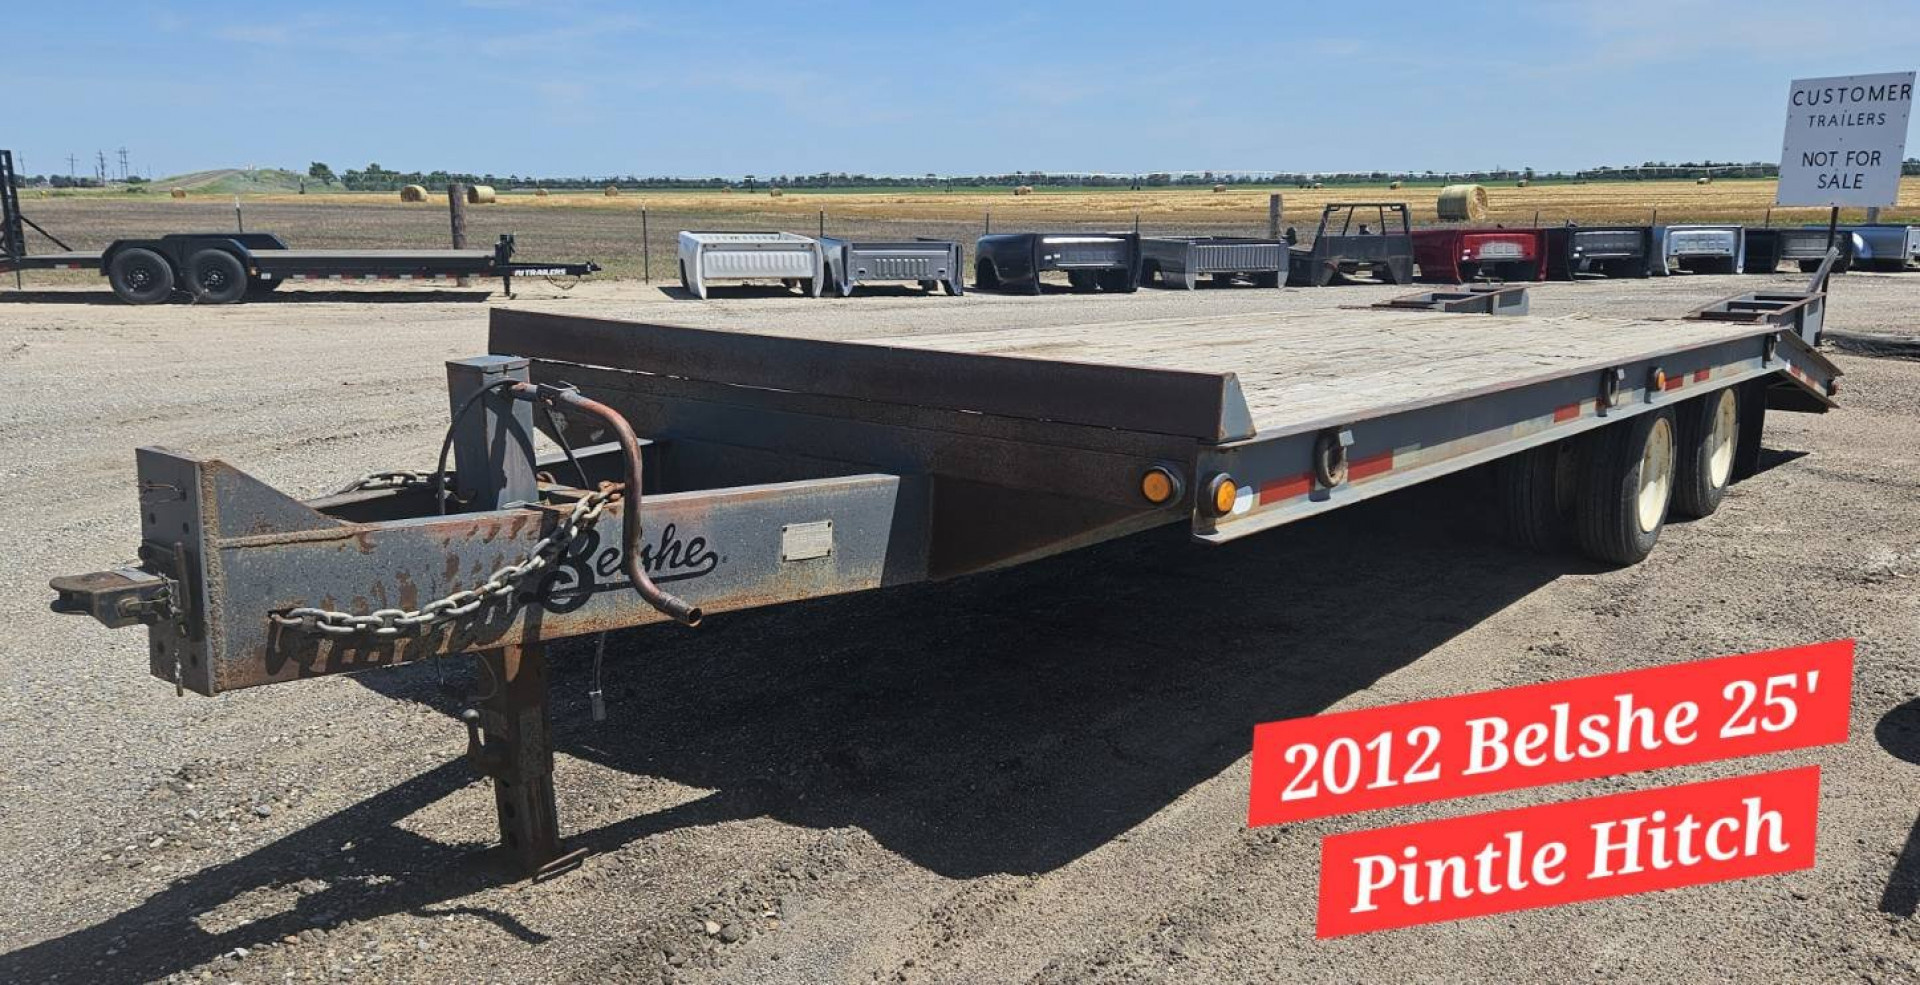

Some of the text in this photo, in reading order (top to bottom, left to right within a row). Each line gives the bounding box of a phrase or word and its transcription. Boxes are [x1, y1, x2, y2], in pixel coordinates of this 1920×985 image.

[1792, 83, 1912, 106] CUSTOMER
[1808, 112, 1887, 128] TRAILERS
[1802, 150, 1881, 167] NOT FOR
[1817, 173, 1864, 189] SALE
[525, 268, 567, 276] TRAILERS
